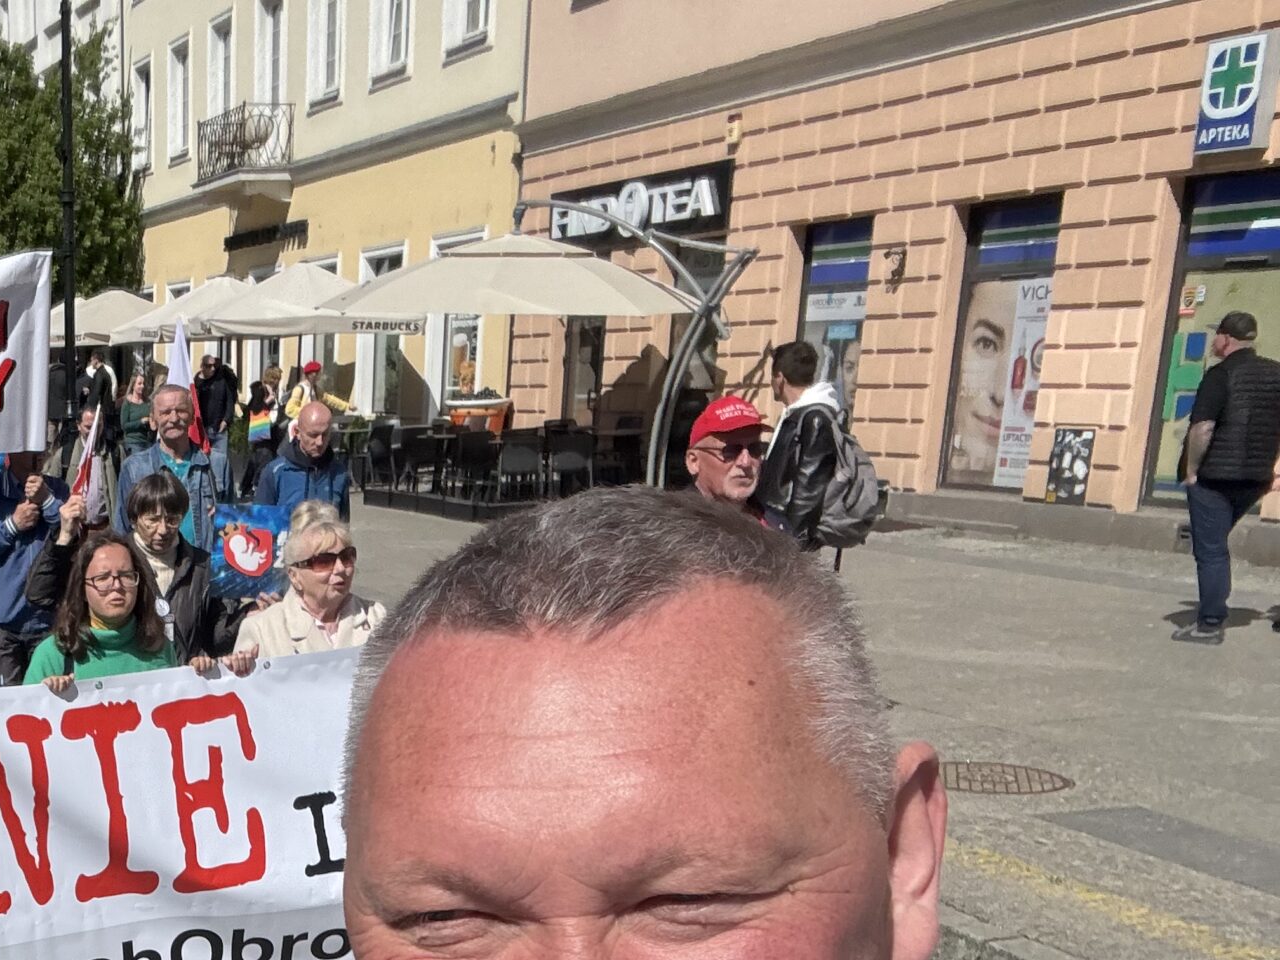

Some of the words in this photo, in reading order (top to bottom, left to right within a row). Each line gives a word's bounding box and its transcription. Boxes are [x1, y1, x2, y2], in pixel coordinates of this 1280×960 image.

[1198, 123, 1249, 145] APTEKA
[648, 176, 716, 224] TEA
[351, 320, 420, 332] STARBUCKS
